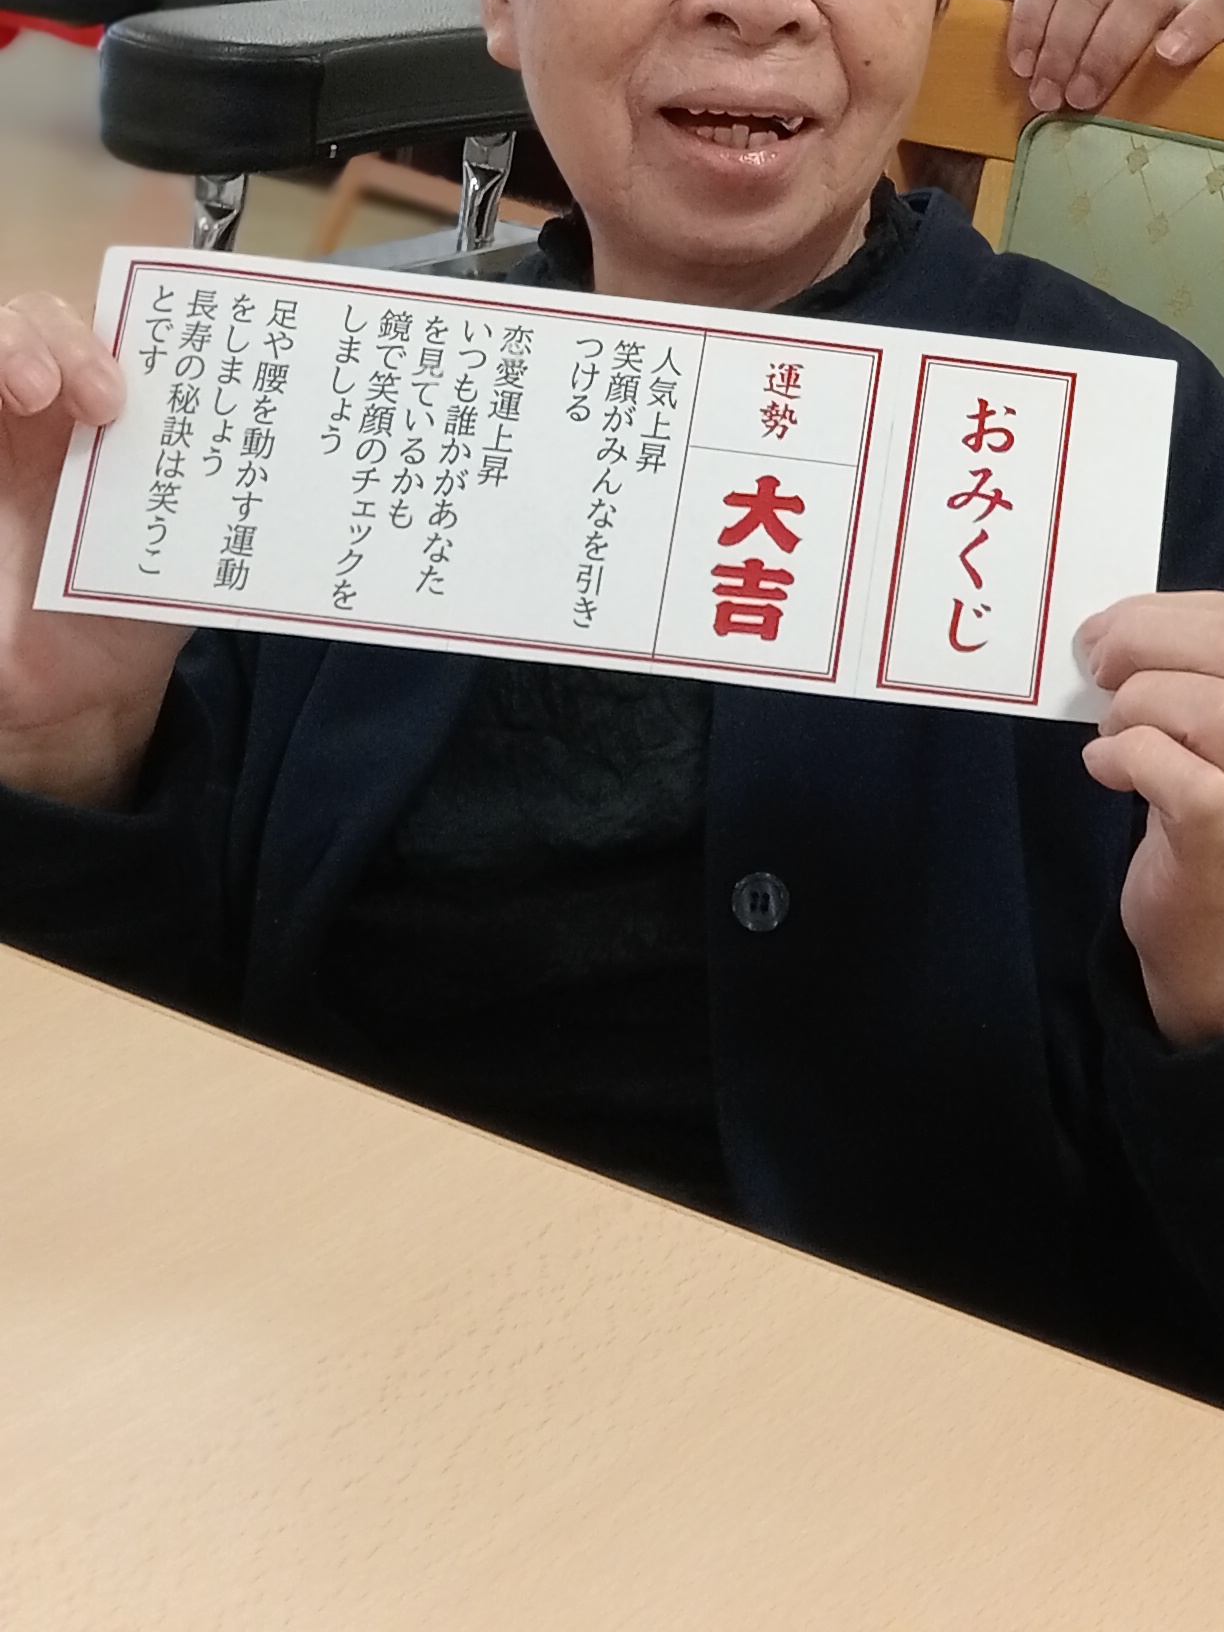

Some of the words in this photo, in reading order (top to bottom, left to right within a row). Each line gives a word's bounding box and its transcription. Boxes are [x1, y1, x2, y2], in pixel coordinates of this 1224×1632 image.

[138, 284, 175, 376] とです
[202, 292, 256, 477] をしましょう
[320, 304, 368, 456] しましょう
[388, 315, 449, 530] を見ているかも
[477, 325, 534, 488] 恋愛運上昇
[566, 337, 604, 422] つける
[636, 346, 682, 474] 人気上昇
[759, 362, 804, 441] 運勢
[138, 288, 219, 575] 長寿の秘訣は笑うこ
[213, 298, 298, 592] 足や腰を動かす運動
[332, 308, 414, 611] 鏡で笑顔のチェックを
[415, 319, 493, 596] いつも誰かがあなた
[573, 339, 646, 629] 笑顔がみんなを引き
[711, 474, 806, 642] 大吉
[946, 397, 1017, 654] おみくじ
